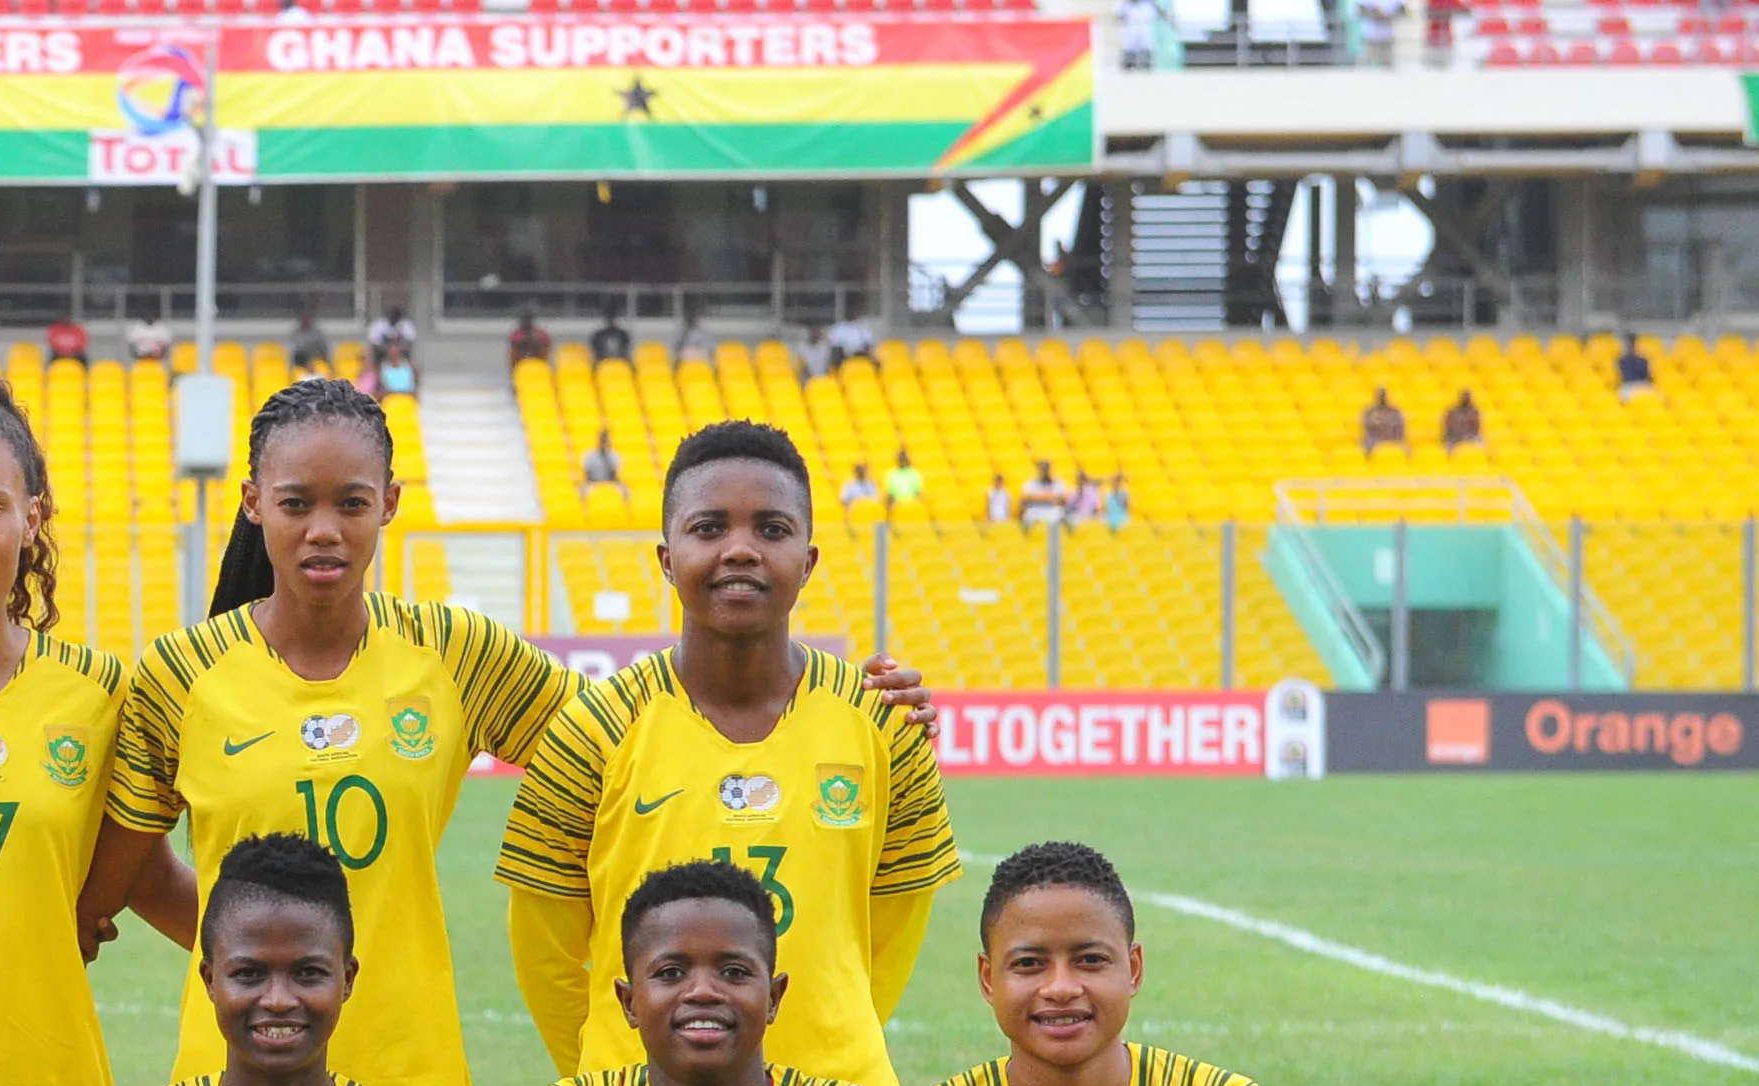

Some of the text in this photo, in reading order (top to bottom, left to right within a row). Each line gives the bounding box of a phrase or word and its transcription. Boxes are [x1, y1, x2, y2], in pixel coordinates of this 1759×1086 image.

[268, 26, 475, 69] GHANA
[491, 24, 877, 67] SUPPORTERS
[90, 136, 256, 174] TOTL
[1525, 699, 1742, 765] Orange
[295, 774, 388, 870] 10
[709, 845, 794, 938] 3
